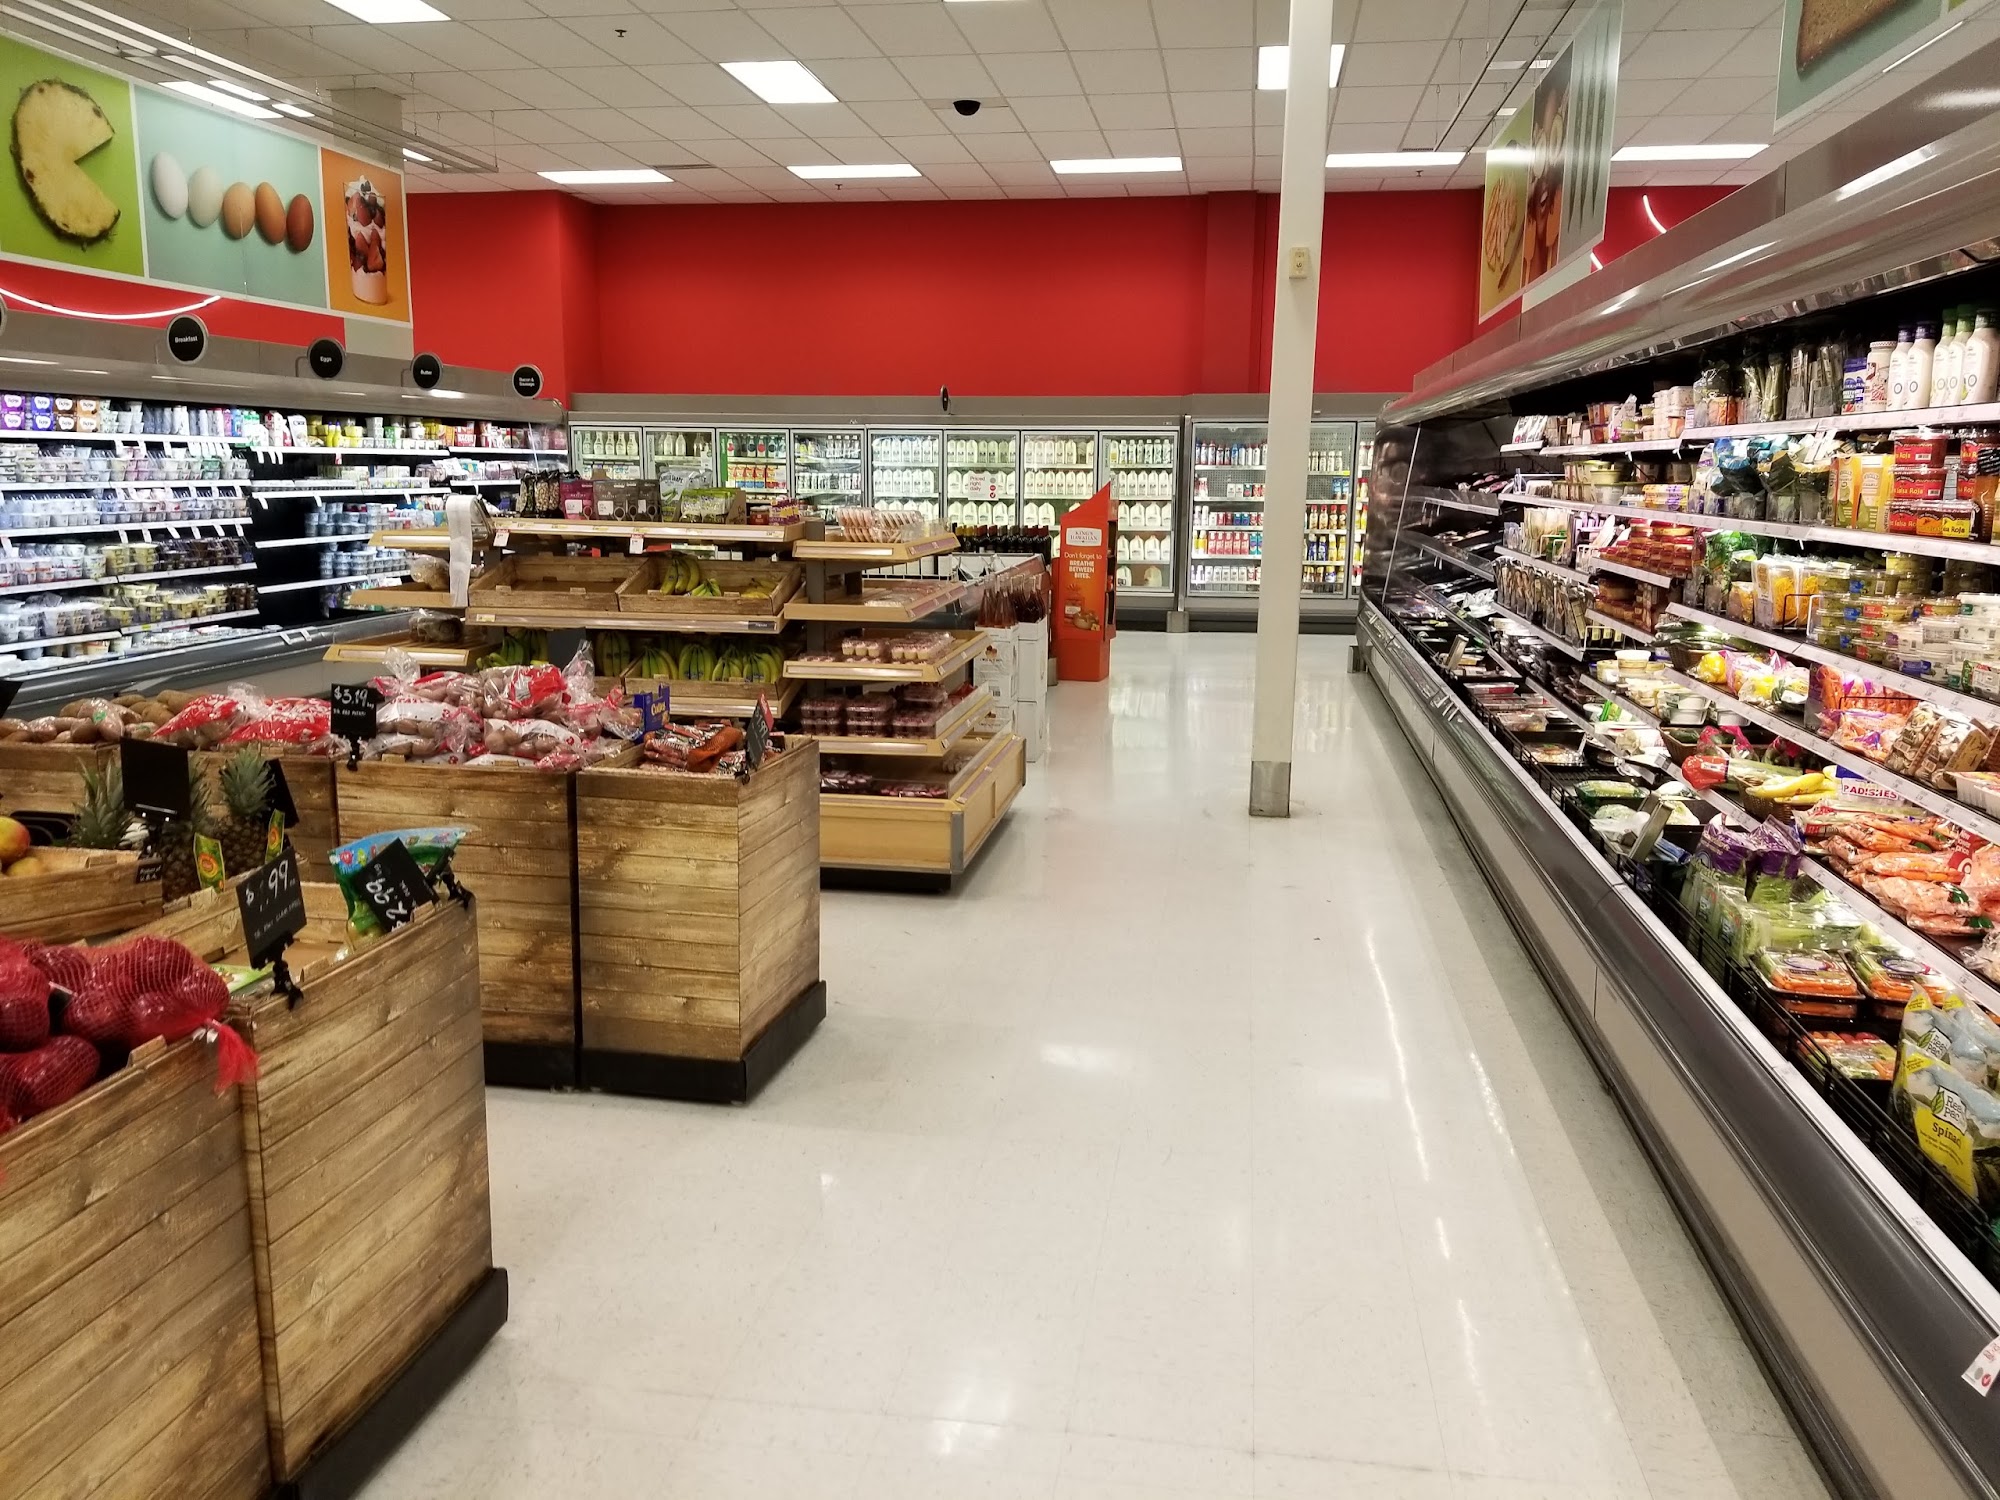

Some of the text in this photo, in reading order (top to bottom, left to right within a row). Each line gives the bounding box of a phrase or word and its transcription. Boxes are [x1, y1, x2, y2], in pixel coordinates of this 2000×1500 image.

[174, 335, 198, 343] Breakfast
[320, 355, 332, 363] Eggs
[1064, 551, 1079, 559] Don't
[1079, 552, 1095, 561] forget
[1931, 1121, 1962, 1150] Spinac
